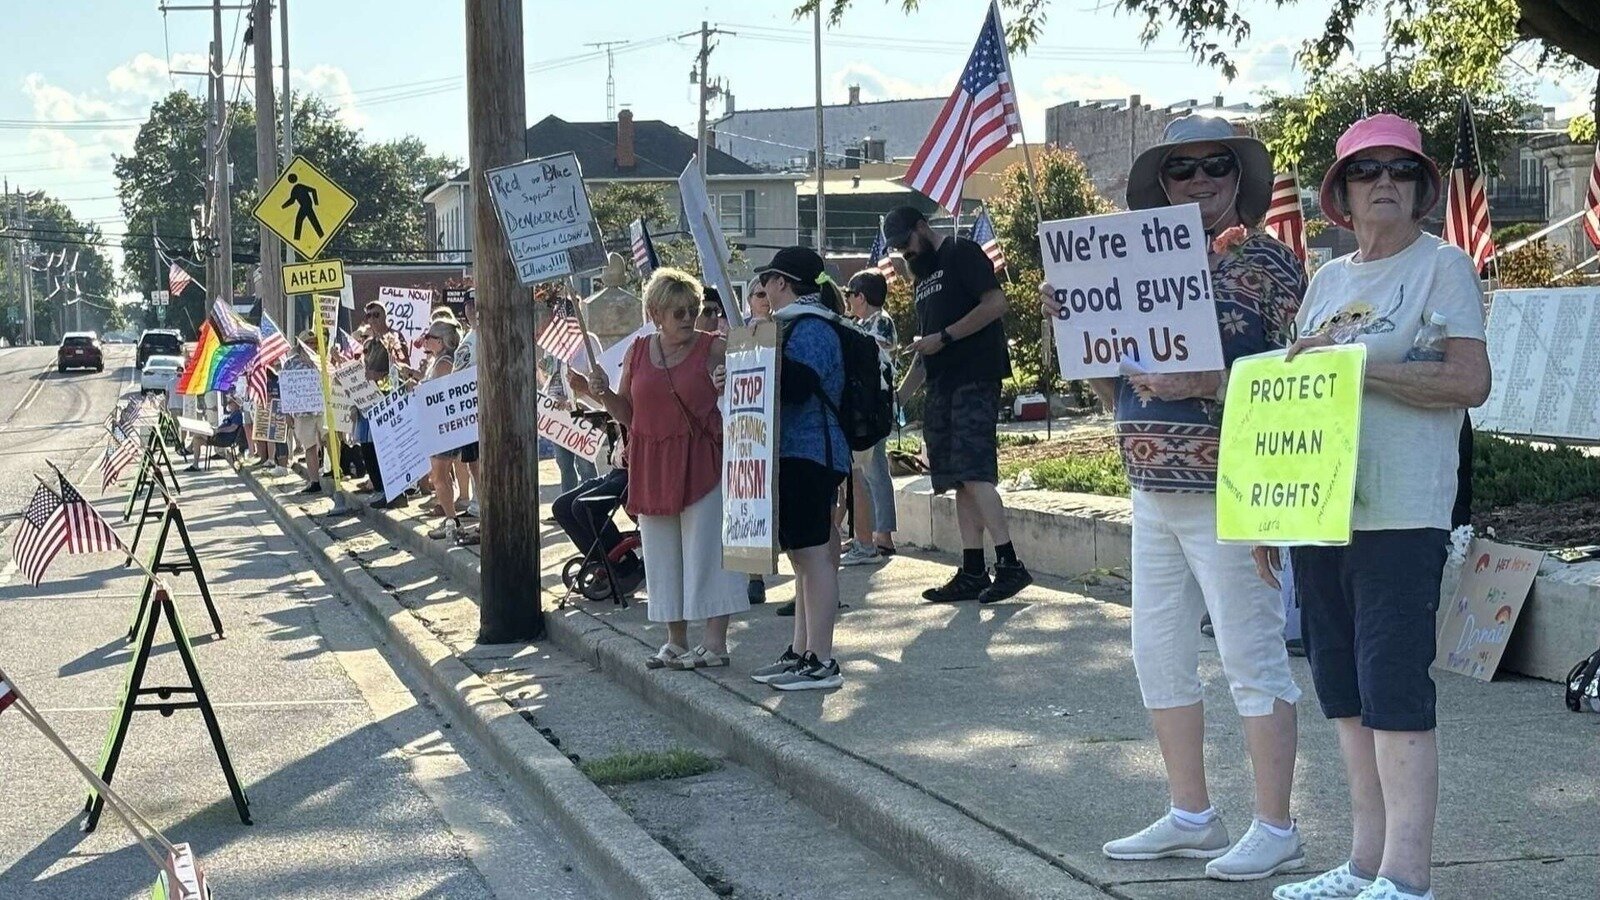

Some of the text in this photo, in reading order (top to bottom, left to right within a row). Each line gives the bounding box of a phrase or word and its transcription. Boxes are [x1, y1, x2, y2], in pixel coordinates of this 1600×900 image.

[492, 173, 520, 199] Red
[540, 163, 572, 182] Blue
[1045, 217, 1191, 263] We're the
[291, 268, 337, 287] AHEAD
[382, 288, 430, 303] CALL NOW!
[1054, 269, 1210, 321] good guys!
[385, 301, 414, 319] (202)
[1083, 327, 1189, 364] Join Us
[425, 382, 478, 406] DUE PROC
[733, 376, 762, 405] STOP
[1250, 373, 1337, 404] PROTECT
[367, 387, 416, 420] FREEDO
[376, 407, 395, 427] WON
[398, 397, 409, 411] BY
[445, 405, 456, 416] IS
[438, 413, 479, 435] EVERYO
[537, 414, 597, 456] UCTIONS
[1255, 430, 1323, 456] HUMAN
[727, 459, 766, 499] RACISM
[1251, 482, 1320, 508] RIGHTS
